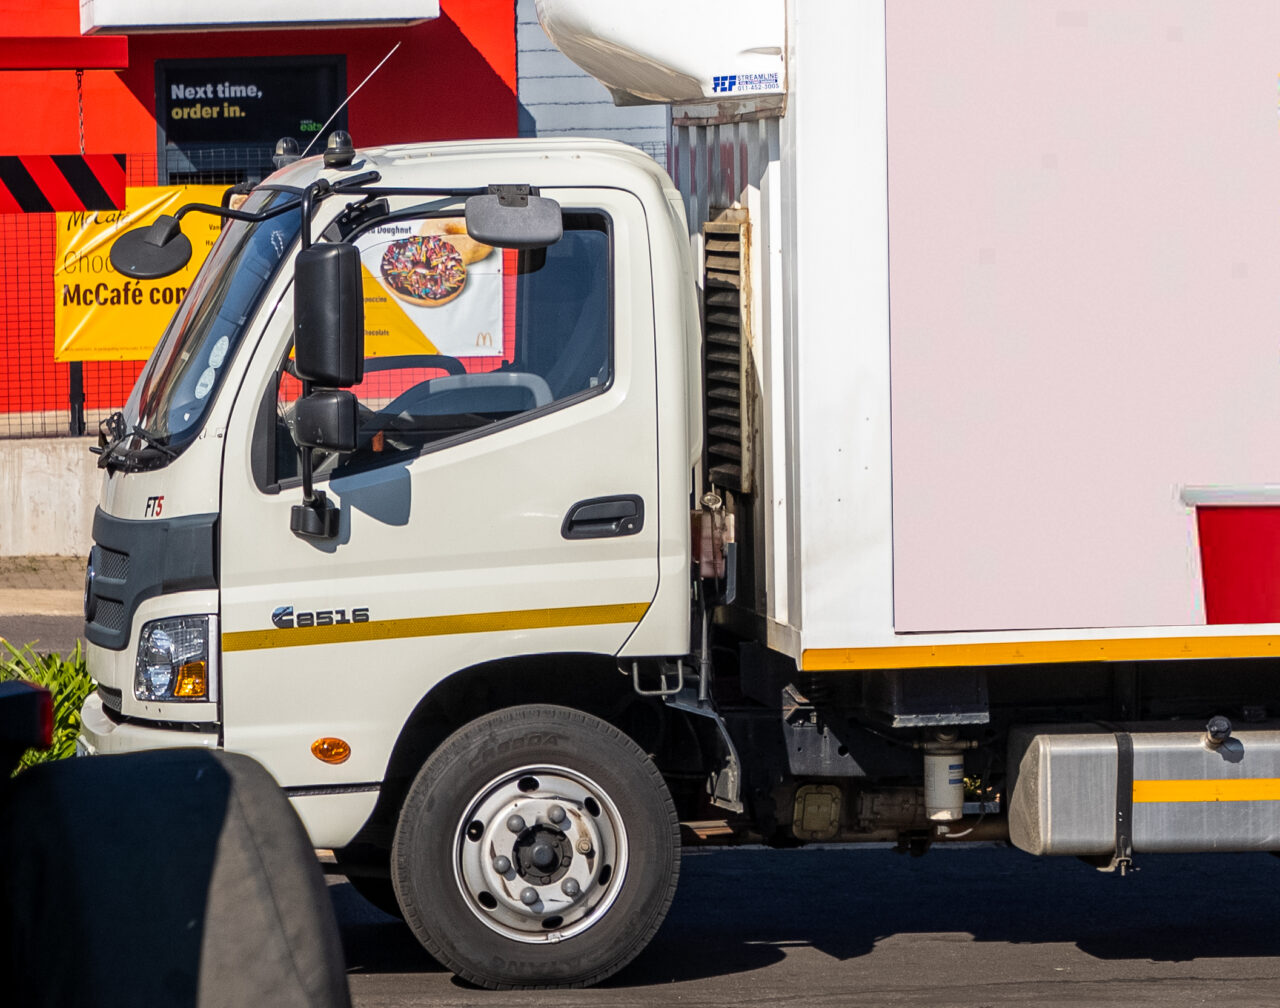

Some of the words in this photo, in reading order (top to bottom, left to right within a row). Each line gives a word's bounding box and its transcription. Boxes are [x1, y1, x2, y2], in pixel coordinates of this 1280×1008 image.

[737, 73, 778, 81] STREAMLINE
[171, 84, 213, 99] Next
[216, 81, 263, 99] time,
[171, 103, 220, 120] order
[223, 102, 246, 118] in.
[63, 279, 143, 307] McCafé
[144, 495, 165, 518] FT5
